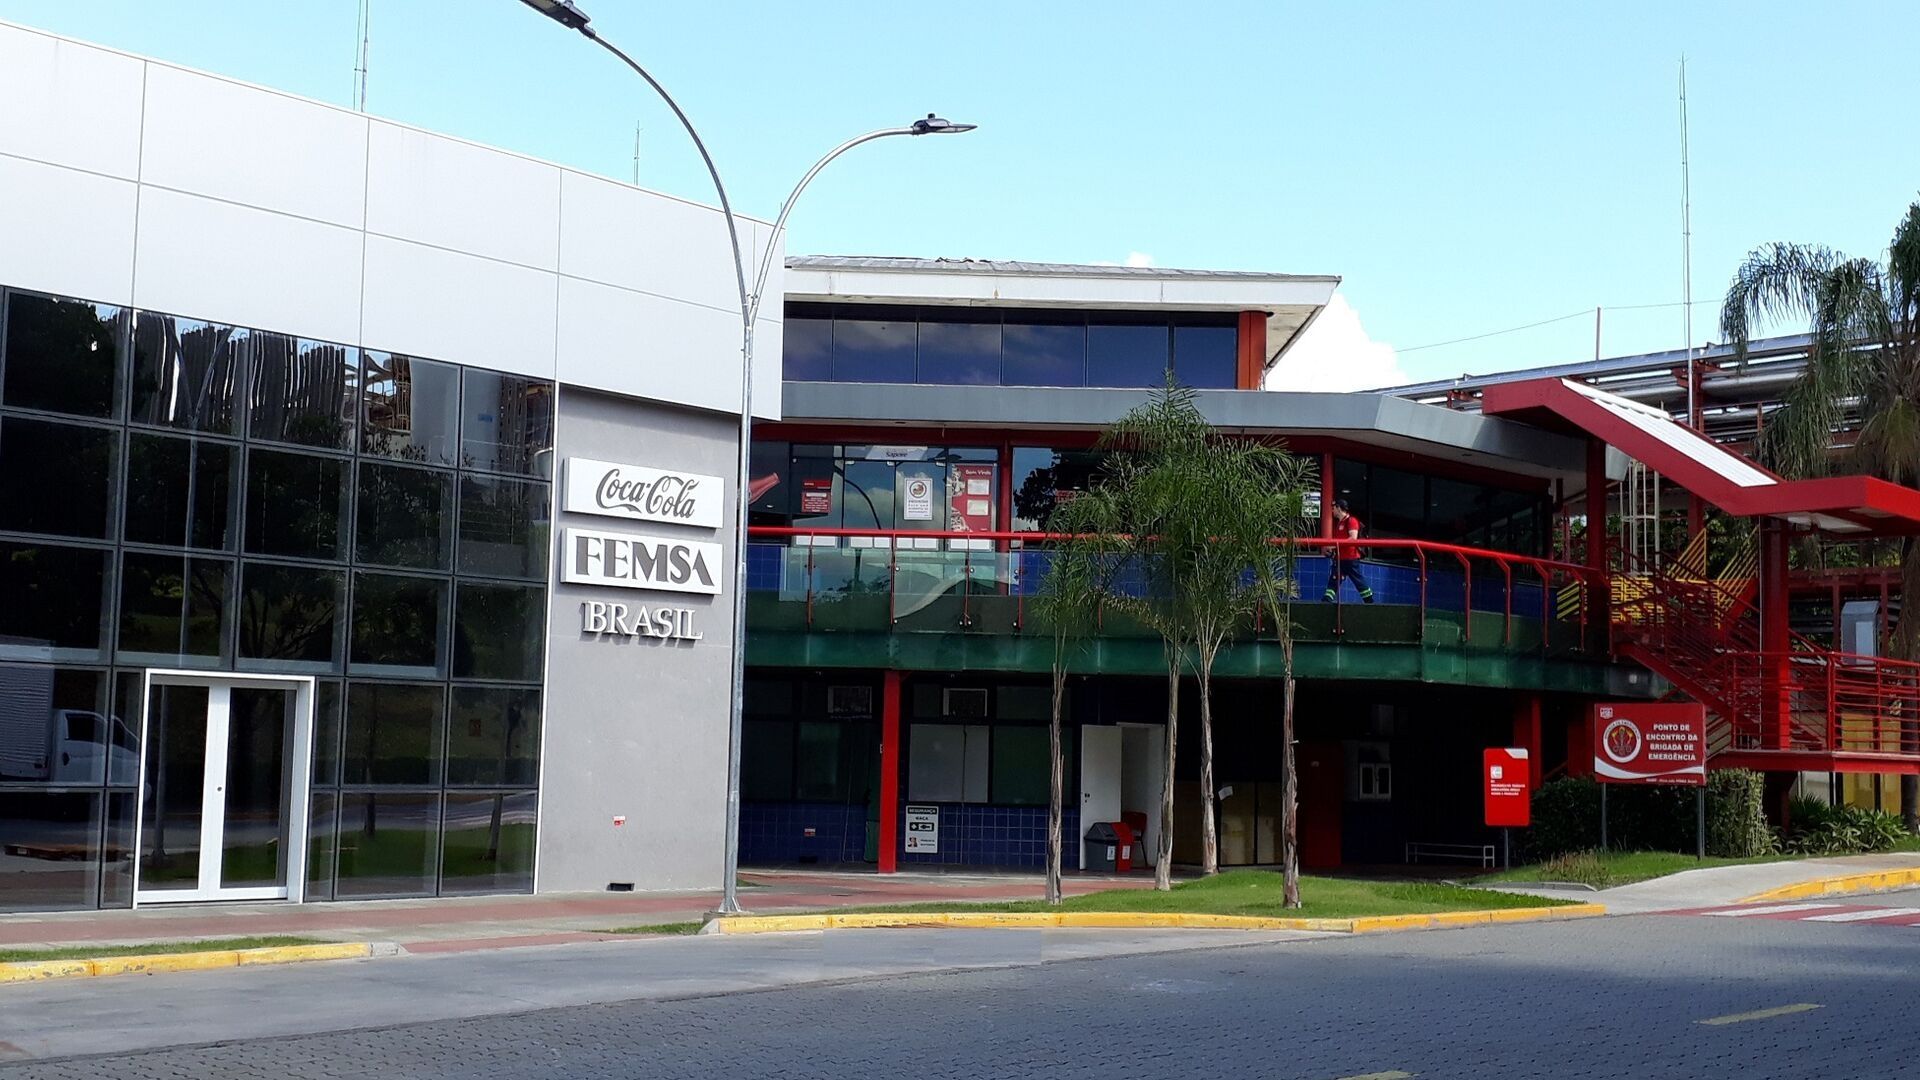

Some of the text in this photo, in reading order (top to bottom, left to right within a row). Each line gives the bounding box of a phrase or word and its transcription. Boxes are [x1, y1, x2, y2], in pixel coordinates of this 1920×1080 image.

[596, 468, 699, 518] Coca-Cola
[575, 535, 715, 587] FEMSA
[584, 600, 704, 640] BRASIL
[1653, 723, 1679, 731] PONTO
[1646, 733, 1686, 741] ENCONTRO
[1650, 743, 1682, 751] BRIGADA
[1648, 752, 1696, 761] EMERGÊNCIA
